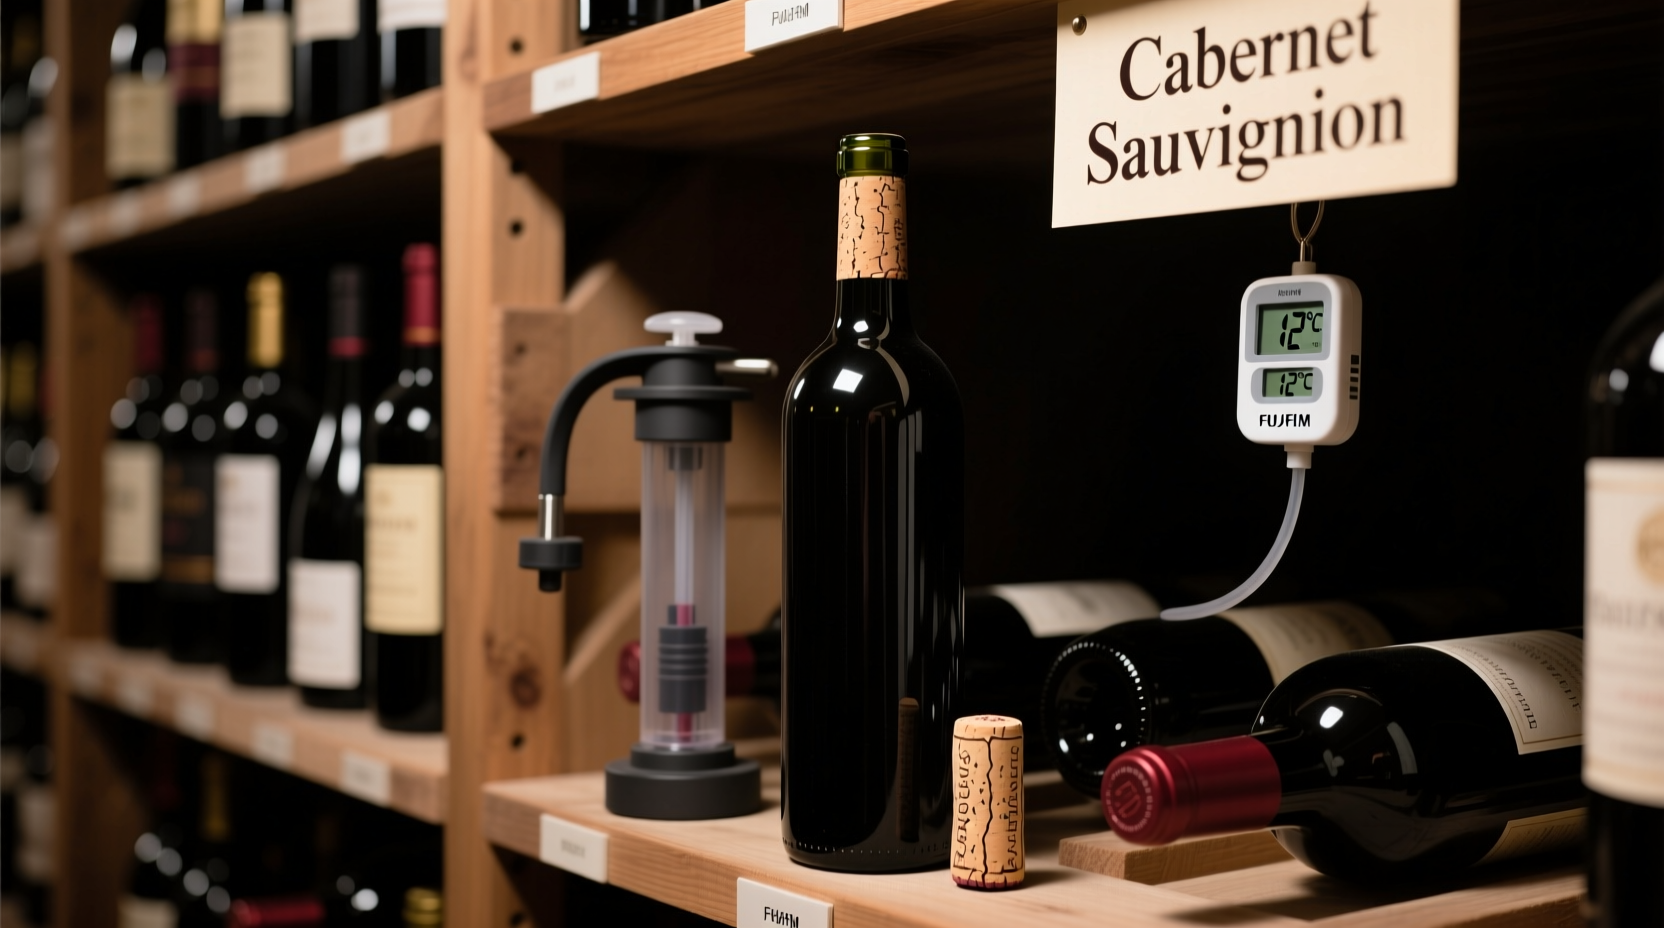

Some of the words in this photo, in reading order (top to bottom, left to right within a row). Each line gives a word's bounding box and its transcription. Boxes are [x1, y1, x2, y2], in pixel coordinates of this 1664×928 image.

[1119, 1, 1379, 101] Cabernet
[1087, 88, 1406, 186] Sauvignion
[1280, 372, 1313, 397] 12°C
